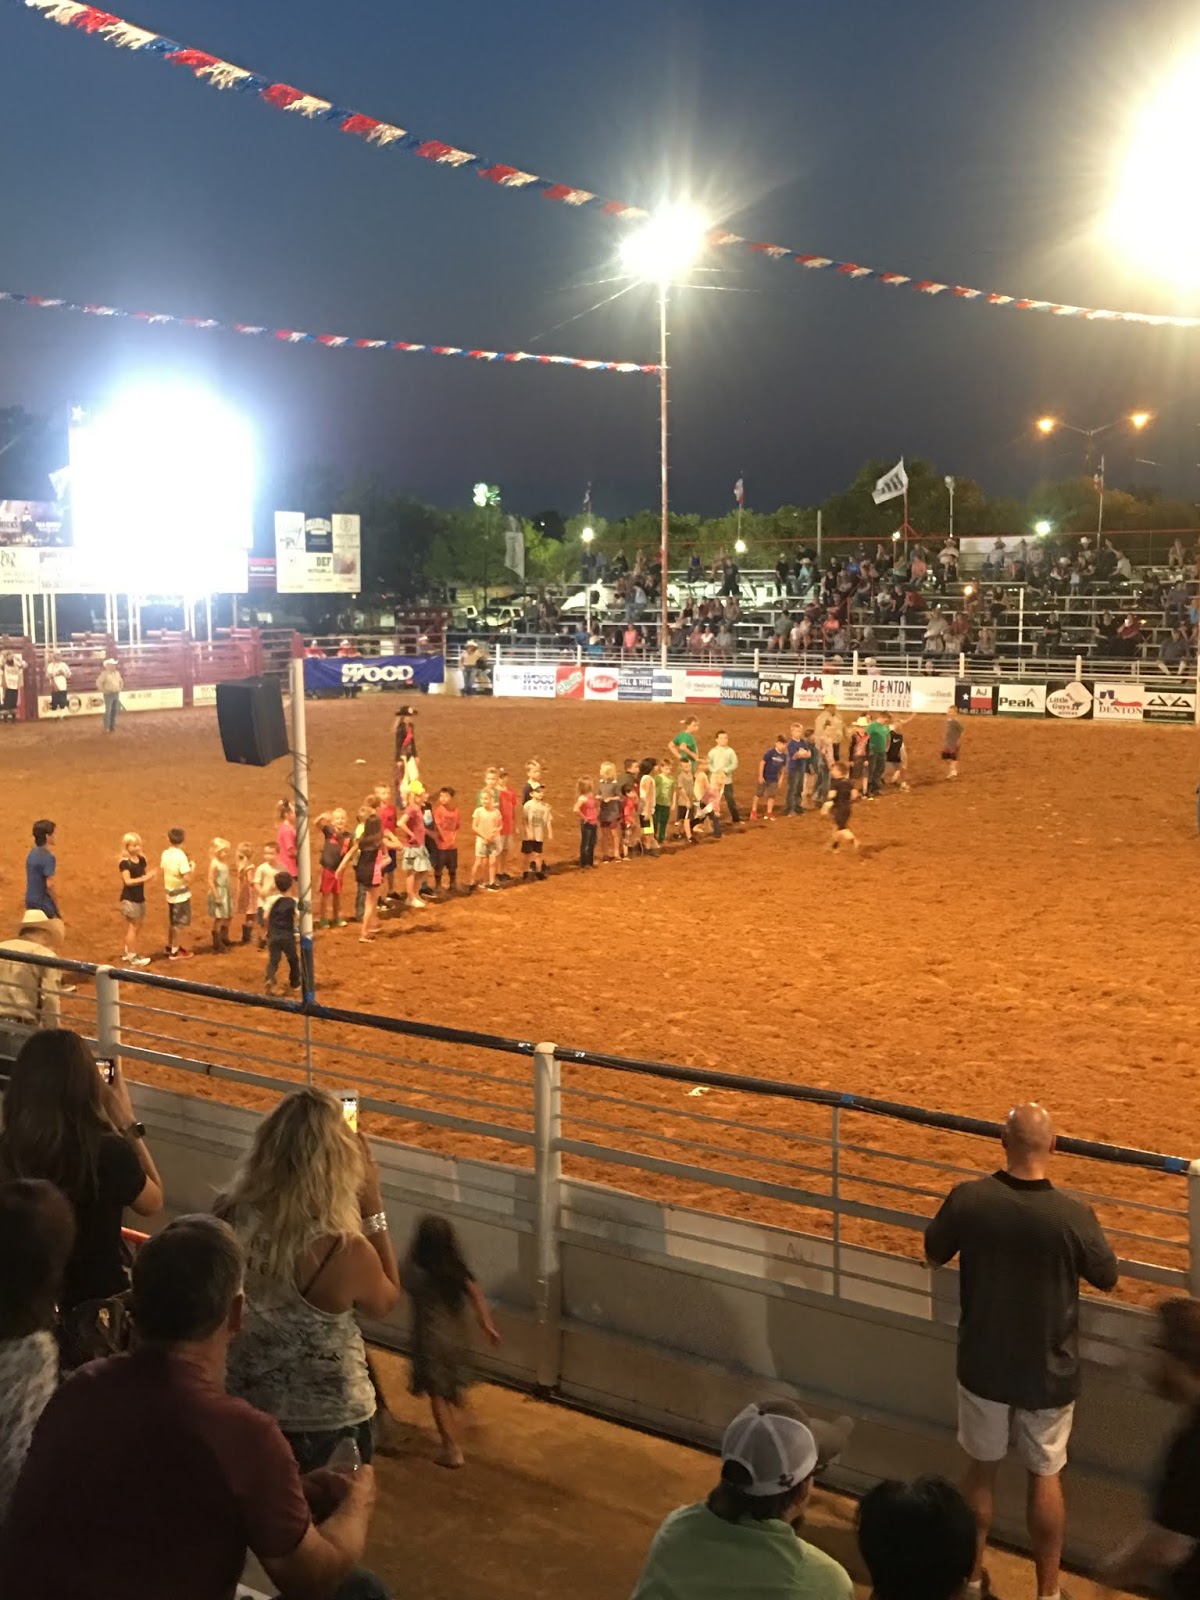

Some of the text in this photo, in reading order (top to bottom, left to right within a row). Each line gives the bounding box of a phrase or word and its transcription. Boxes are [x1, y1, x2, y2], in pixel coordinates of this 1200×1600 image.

[341, 663, 414, 682] WOOD
[759, 681, 791, 697] CAT
[872, 679, 912, 694] DENTON
[720, 689, 750, 700] SOLUTIONS
[976, 688, 988, 696] AJ
[871, 698, 911, 708] ELECTRIC
[999, 697, 1035, 708] Peak
[1049, 696, 1069, 704] Little
[1052, 703, 1071, 711] Guys
[1099, 705, 1143, 715] DENTON
